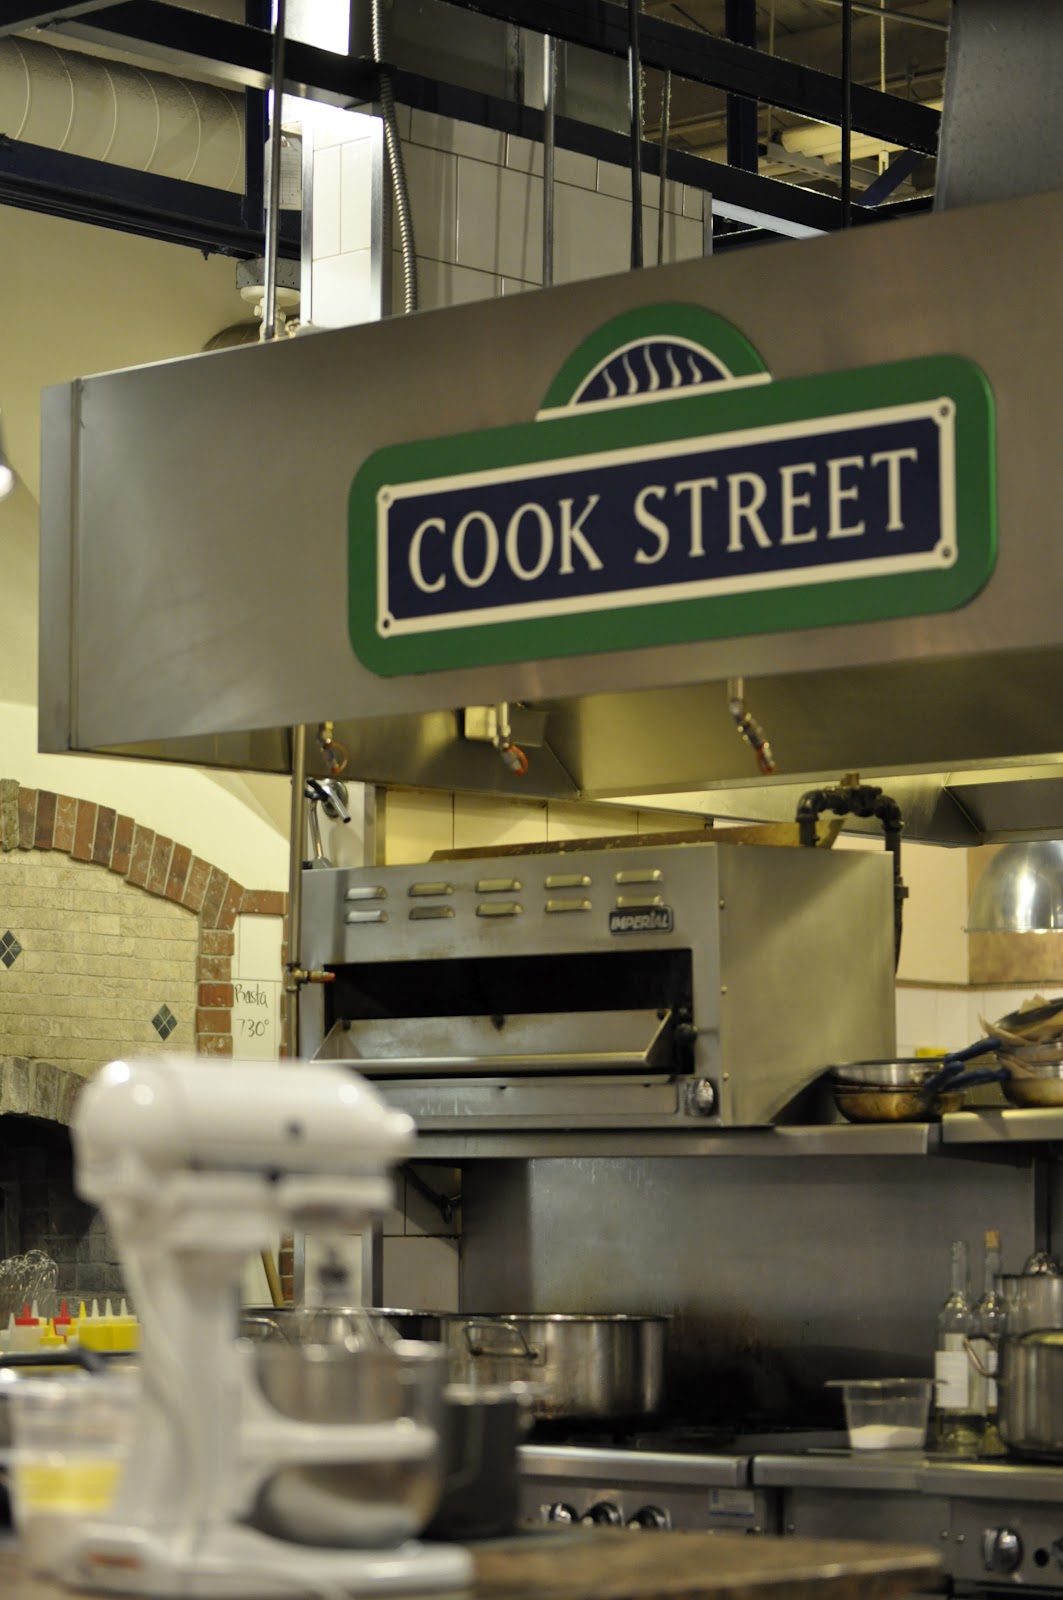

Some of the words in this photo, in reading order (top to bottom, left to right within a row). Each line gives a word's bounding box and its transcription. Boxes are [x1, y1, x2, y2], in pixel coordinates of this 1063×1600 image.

[408, 494, 604, 594] COOK
[633, 447, 918, 565] STREET
[234, 983, 268, 1009] Pasta
